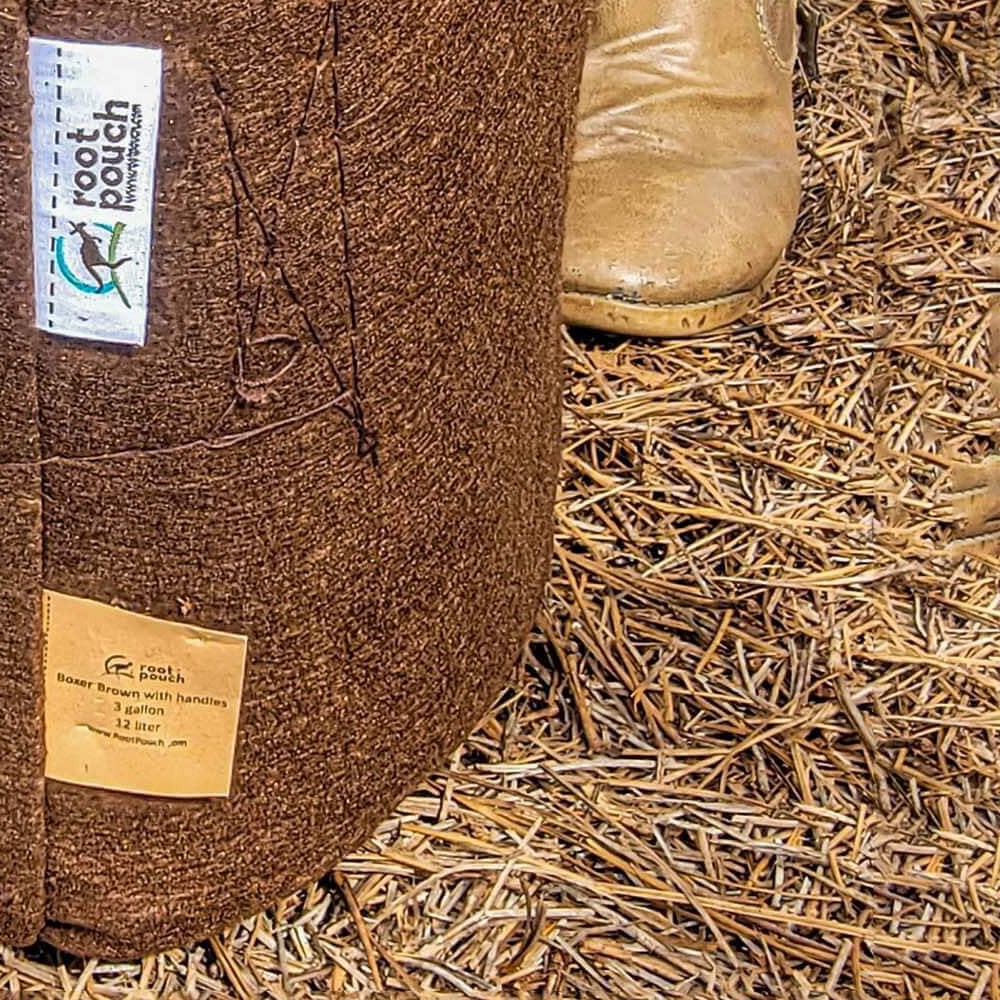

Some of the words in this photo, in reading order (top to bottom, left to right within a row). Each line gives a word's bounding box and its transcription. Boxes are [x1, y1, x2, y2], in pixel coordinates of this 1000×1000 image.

[93, 100, 135, 212] pouch
[67, 128, 100, 207] root
[140, 664, 172, 675] root
[139, 672, 185, 684] pouch
[57, 672, 94, 689] Boxer
[97, 682, 140, 699] Brown
[144, 690, 173, 702] with
[176, 692, 228, 708] handles
[113, 701, 122, 712] 3
[125, 704, 165, 716] gallon
[115, 718, 131, 730] 12
[134, 720, 161, 732] liter
